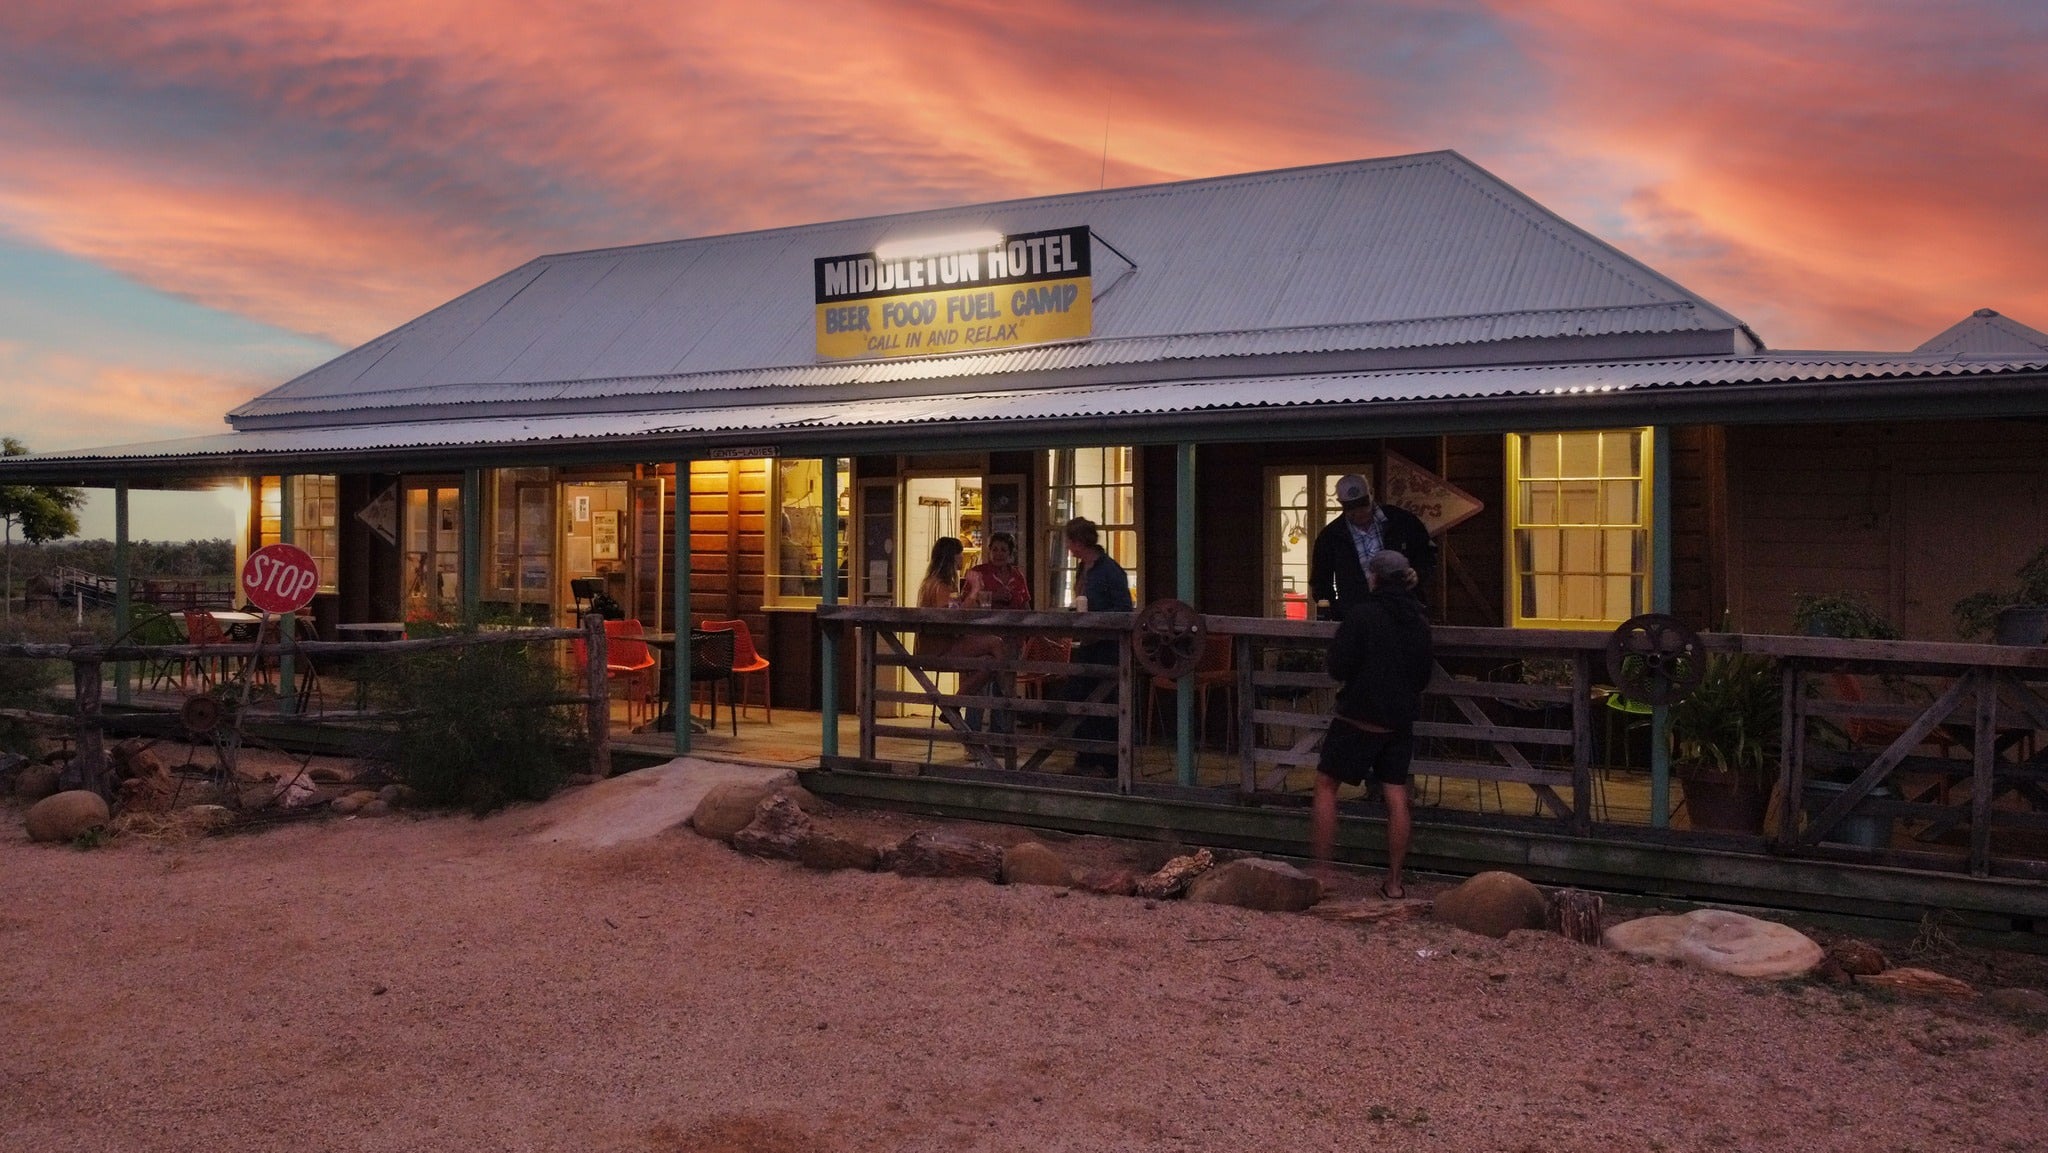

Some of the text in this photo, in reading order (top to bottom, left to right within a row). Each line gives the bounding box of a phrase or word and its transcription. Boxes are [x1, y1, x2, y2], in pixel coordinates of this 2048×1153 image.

[824, 234, 1078, 297] MIDDLETON HOTEL
[825, 283, 1078, 335] BEER FOOD FUEL CAMP
[905, 331, 922, 348] IN
[926, 328, 959, 347] AND
[246, 554, 315, 601] STOP
